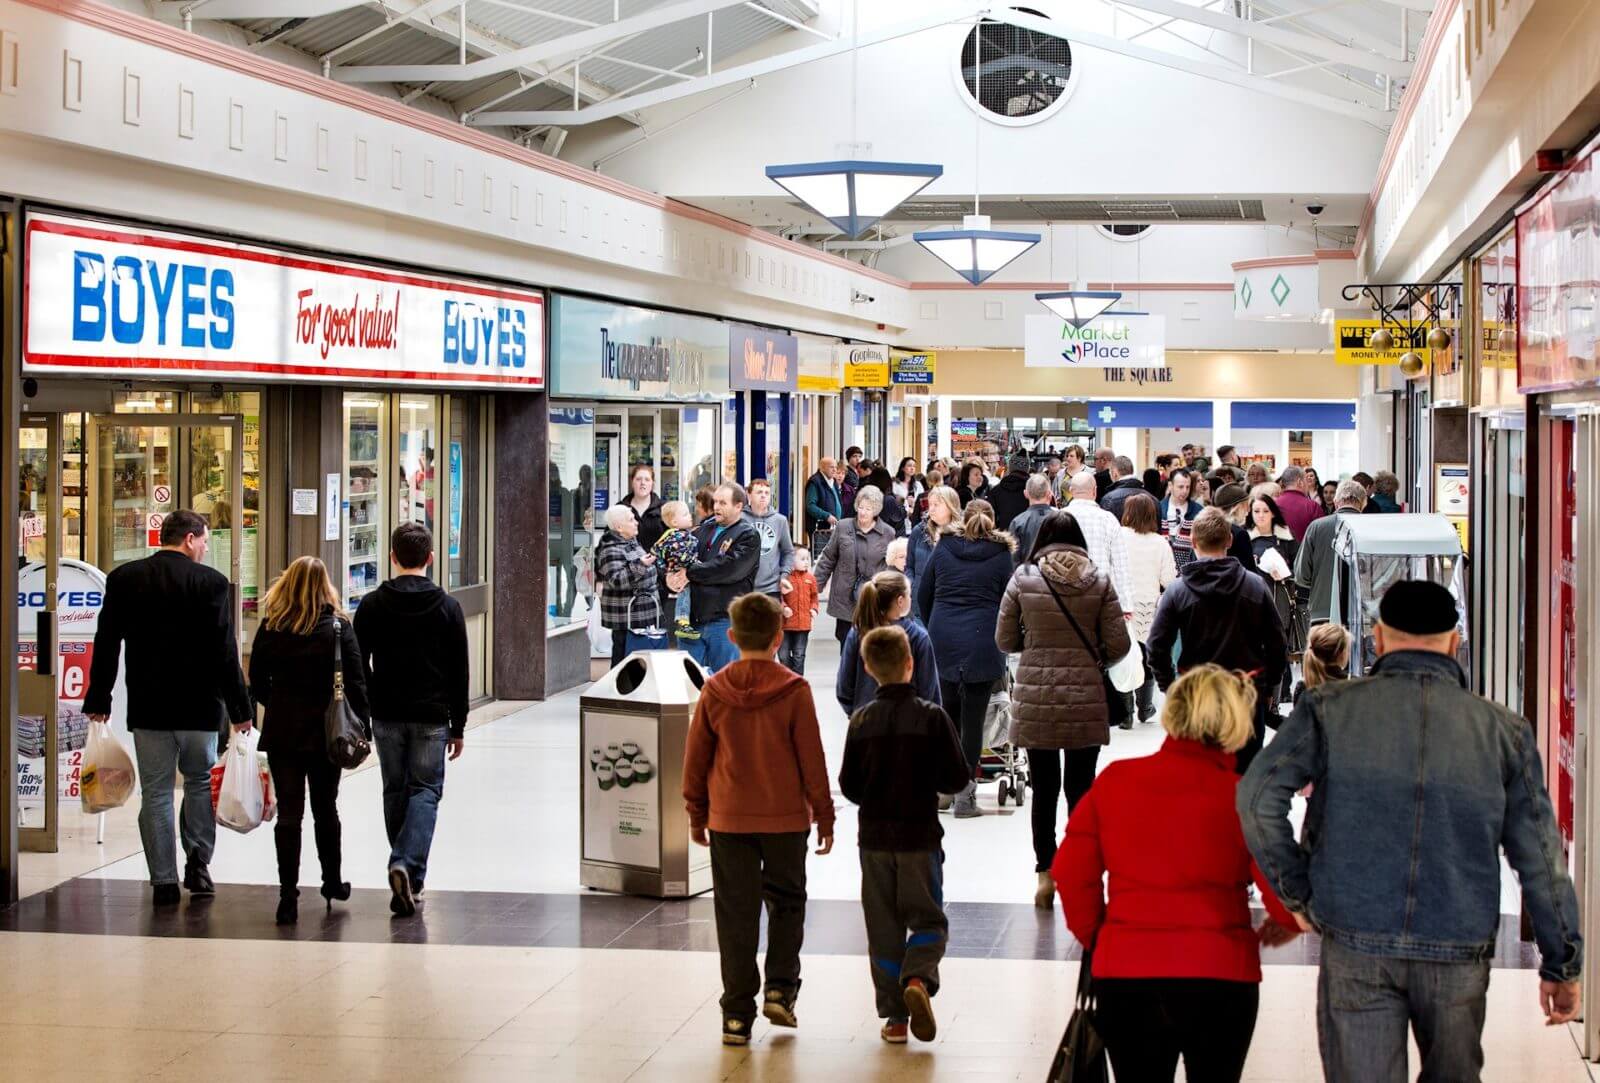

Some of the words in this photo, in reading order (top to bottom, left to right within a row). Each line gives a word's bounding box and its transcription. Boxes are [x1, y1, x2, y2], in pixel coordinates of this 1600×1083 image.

[73, 250, 234, 350] BOYES
[297, 288, 322, 344] For
[321, 293, 359, 360] good
[360, 289, 400, 349] value!
[443, 300, 526, 369] BOYES
[1062, 322, 1130, 340] Market
[600, 328, 615, 379] The
[744, 336, 765, 381] Shoe
[766, 340, 788, 382] Zone
[1083, 342, 1130, 358] Place
[1351, 351, 1380, 359] MONEY
[1103, 367, 1126, 382] THE
[1130, 367, 1173, 385] SQUARE
[20, 774, 43, 785] 80%
